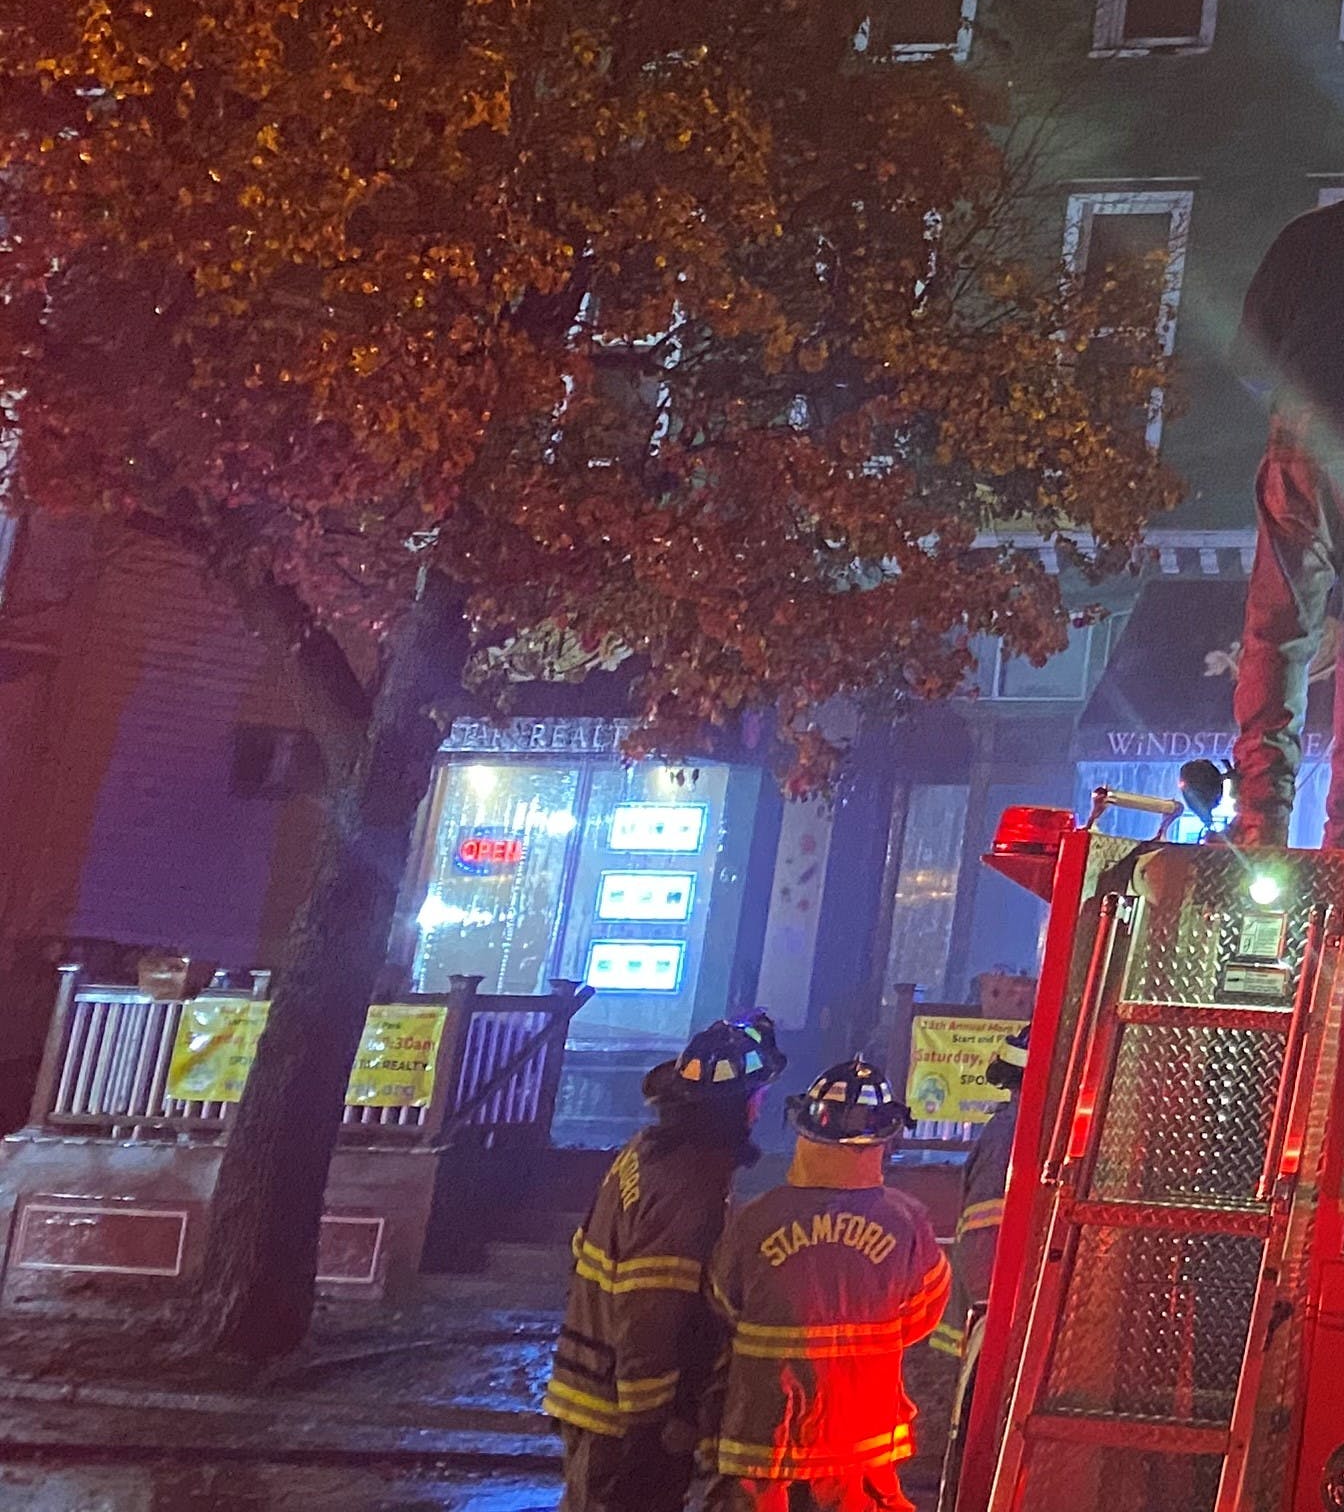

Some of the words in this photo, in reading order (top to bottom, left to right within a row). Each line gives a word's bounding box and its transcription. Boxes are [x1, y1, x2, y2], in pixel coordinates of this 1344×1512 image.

[529, 723, 630, 748] REALT
[459, 838, 523, 862] OPEN
[760, 1212, 897, 1267] STAMFORD
